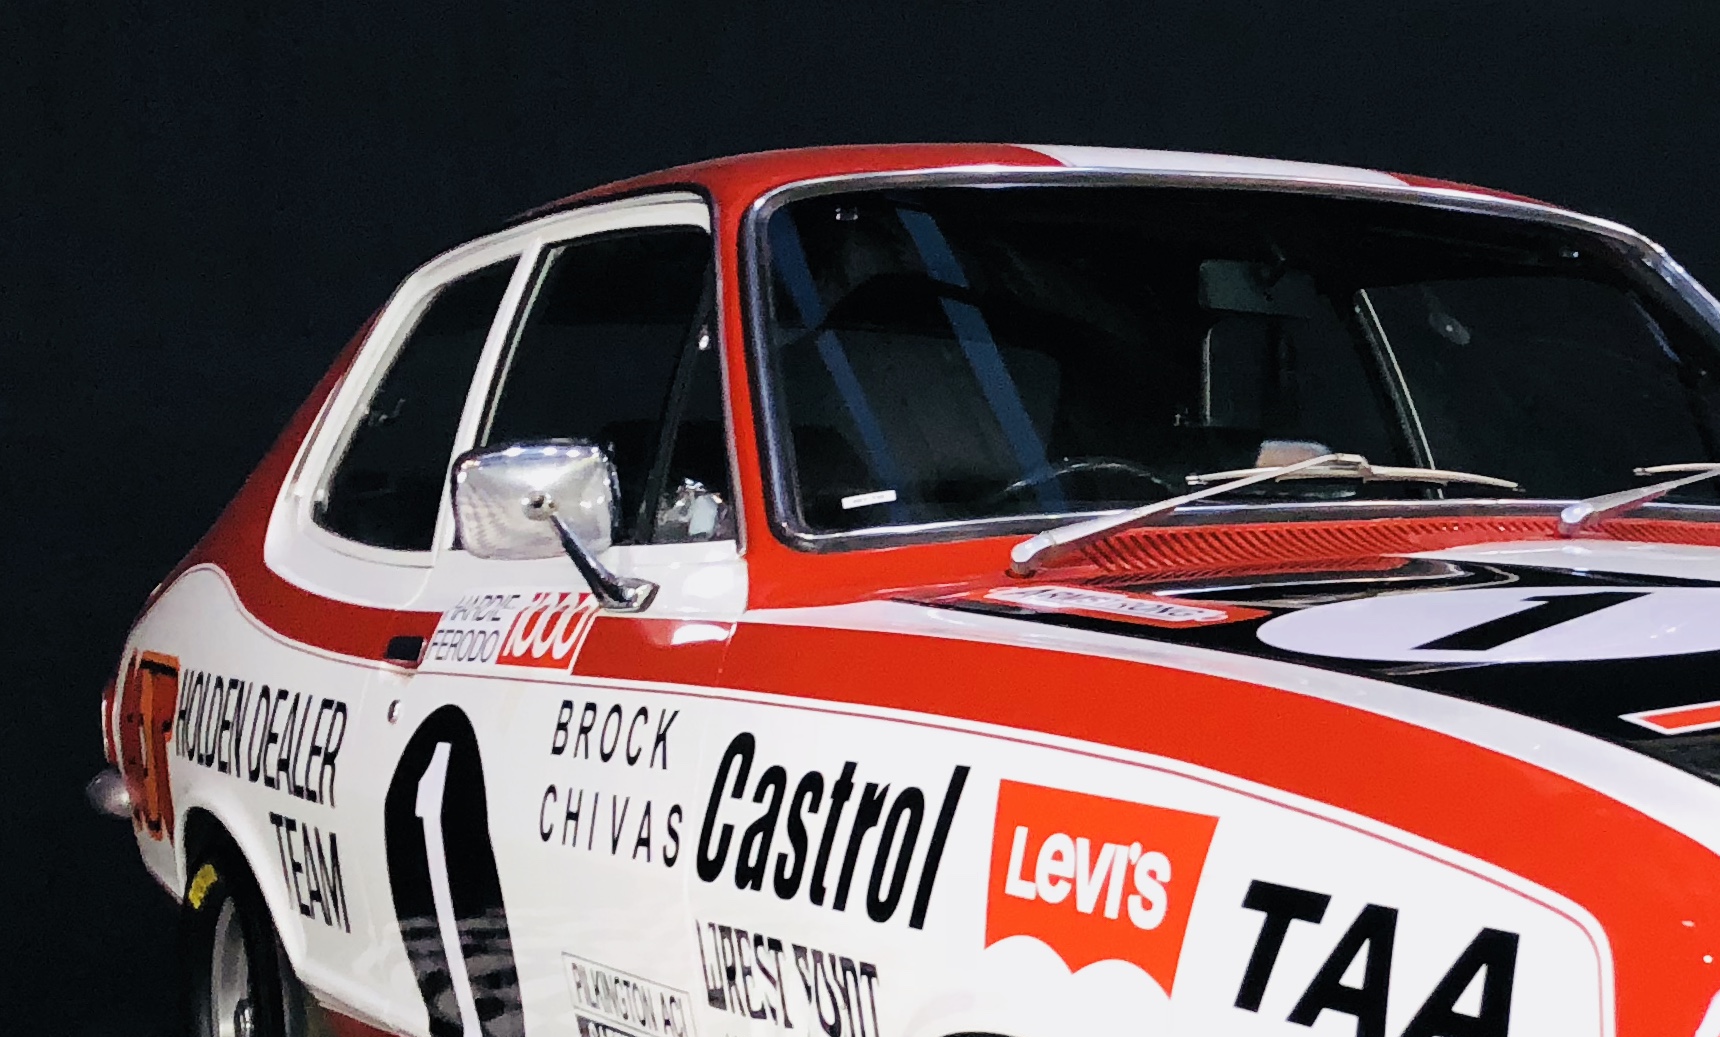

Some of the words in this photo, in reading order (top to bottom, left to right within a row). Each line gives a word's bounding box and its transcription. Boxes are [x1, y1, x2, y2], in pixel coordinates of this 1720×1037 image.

[427, 629, 500, 663] FERODO
[1409, 591, 1658, 651] 1
[175, 669, 253, 778] HOLDEN
[250, 684, 348, 808] DEALER
[551, 700, 680, 770] BROCK
[539, 784, 682, 867] CHIVAS
[696, 731, 971, 930] Castrol
[269, 812, 350, 933] TEAM
